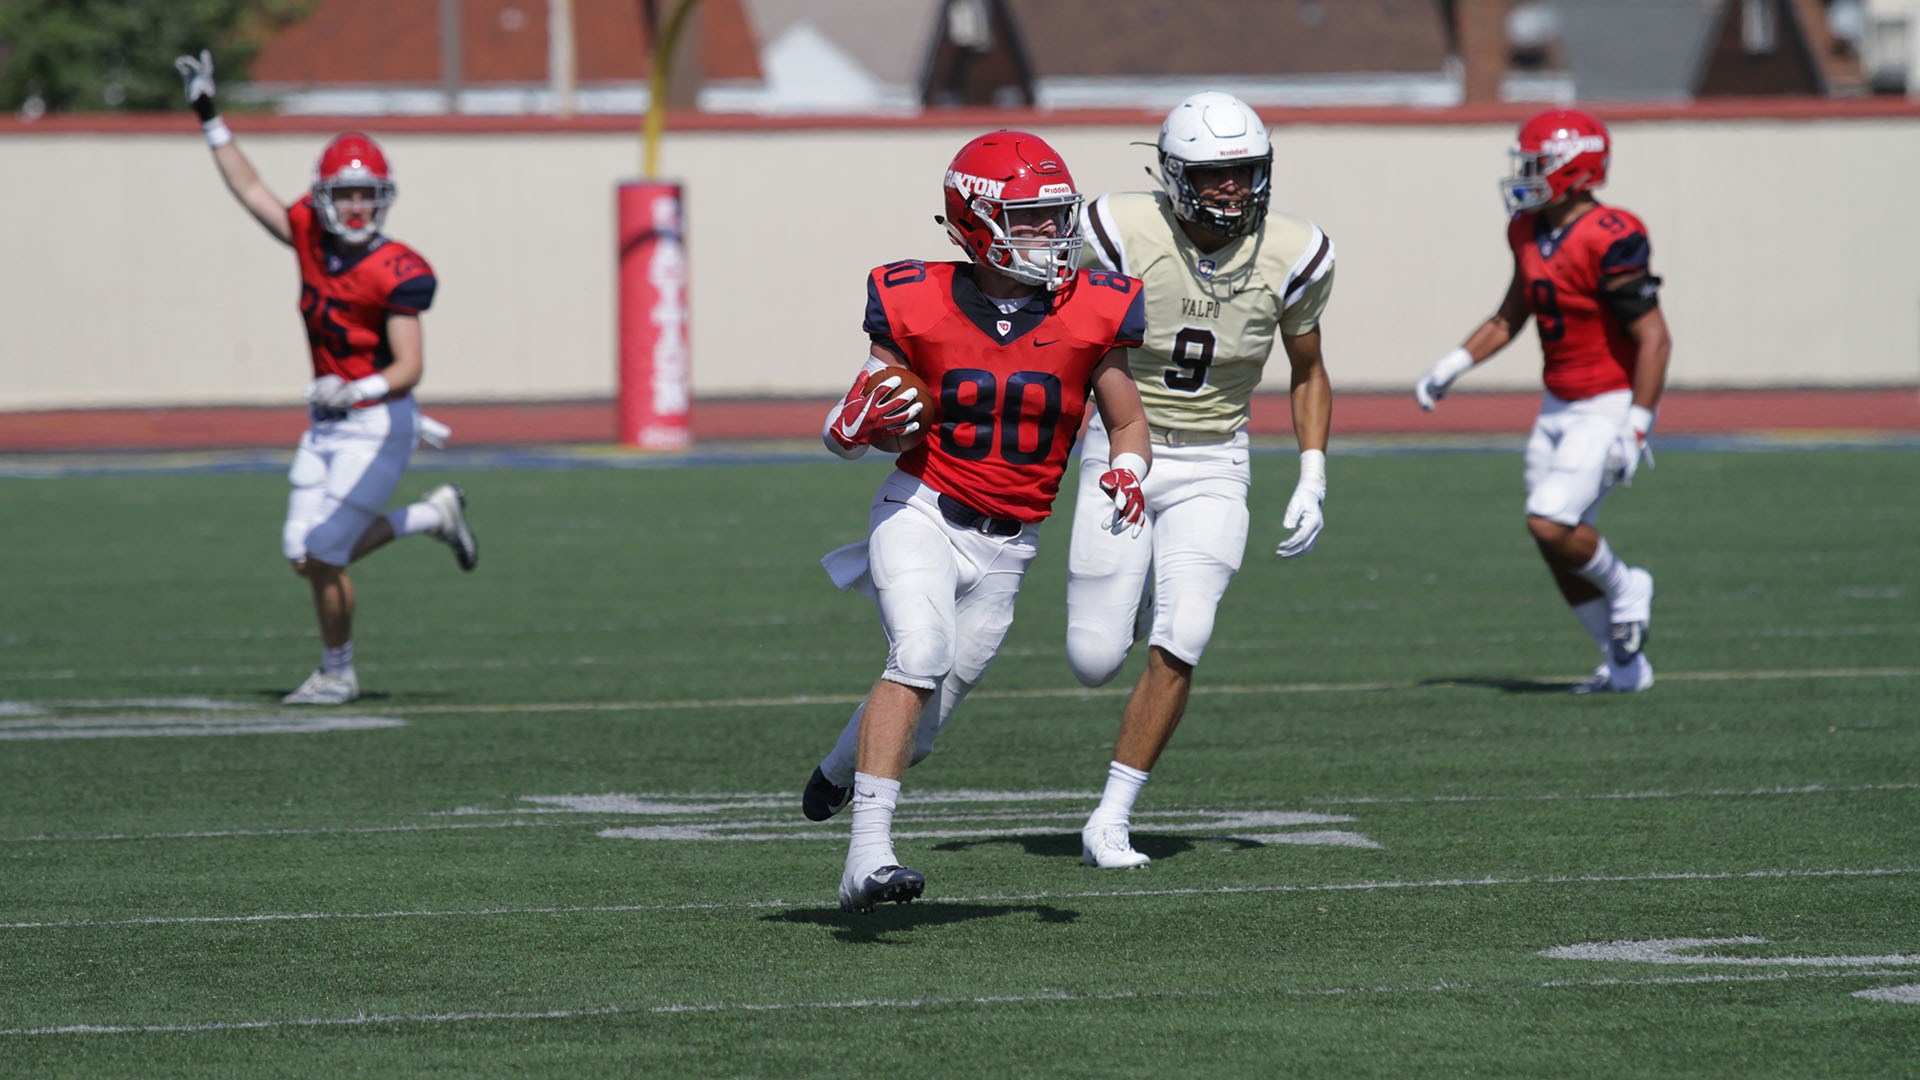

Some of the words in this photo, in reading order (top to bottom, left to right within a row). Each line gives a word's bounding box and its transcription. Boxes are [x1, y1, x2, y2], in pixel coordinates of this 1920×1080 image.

[1182, 298, 1221, 319] VALPO
[1162, 325, 1217, 394] 9
[940, 368, 1062, 466] 80
